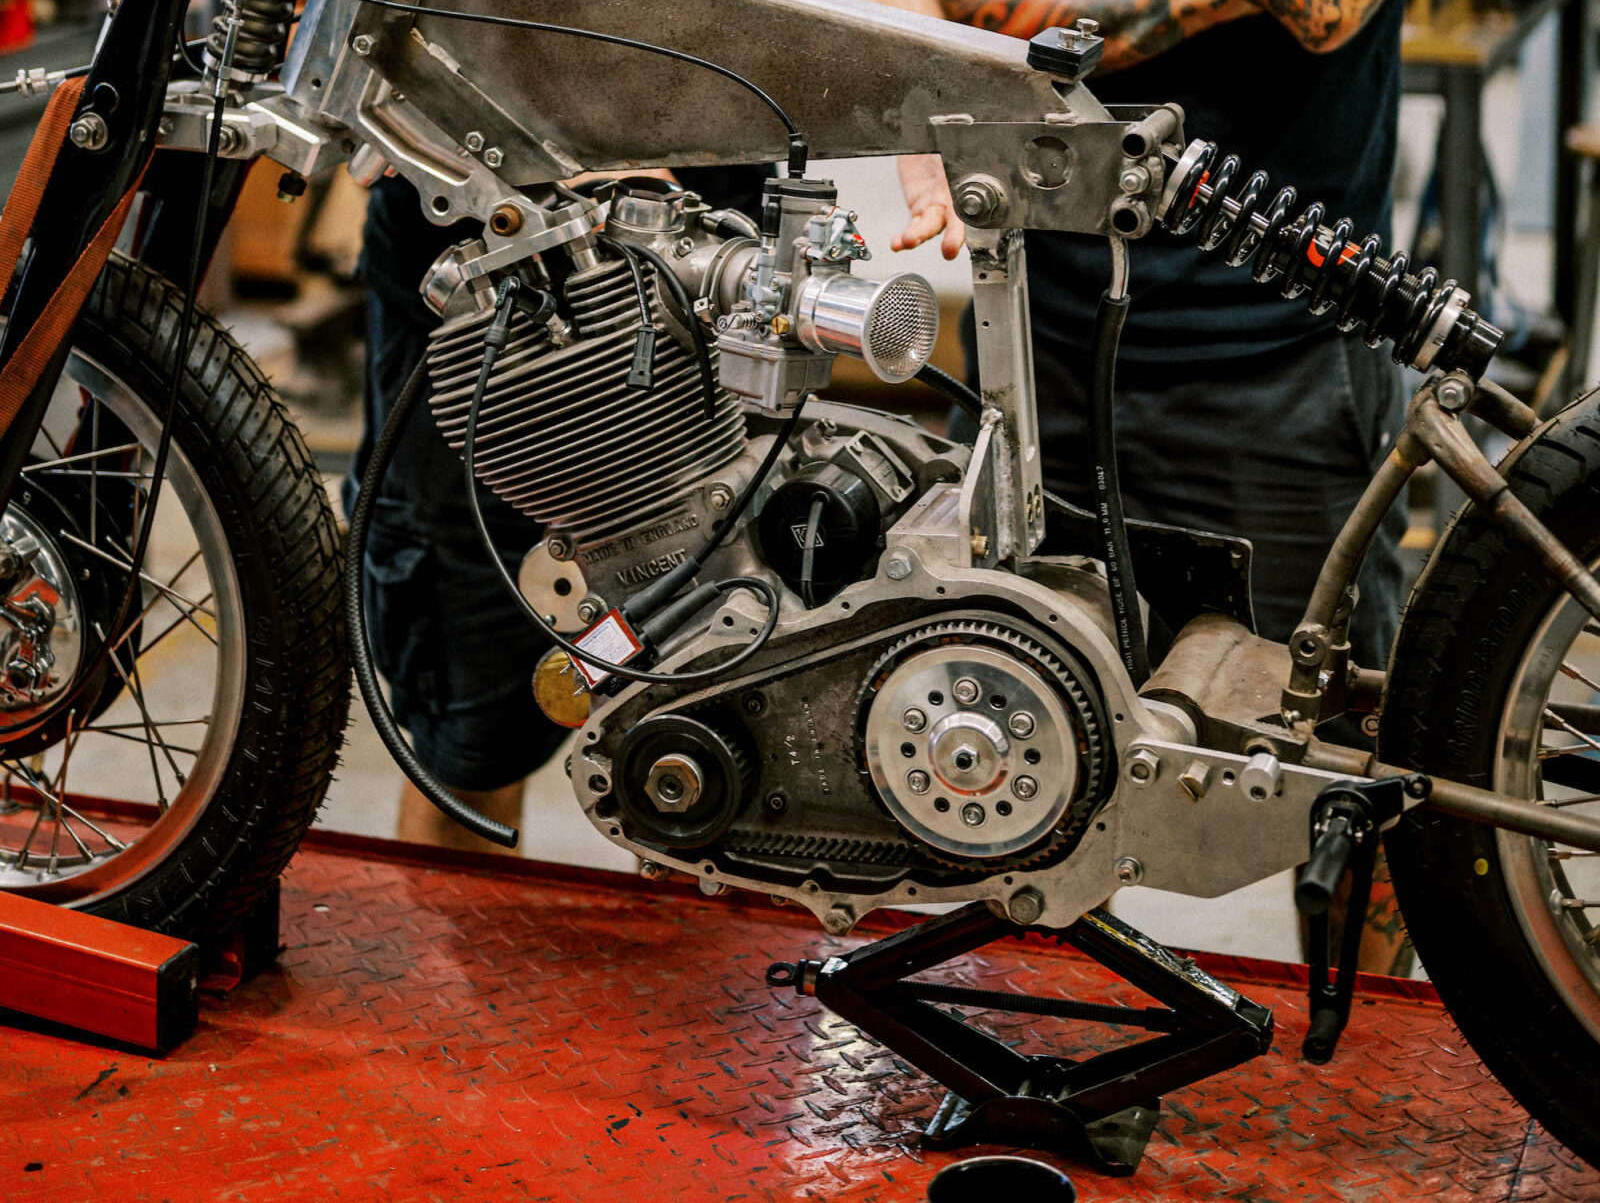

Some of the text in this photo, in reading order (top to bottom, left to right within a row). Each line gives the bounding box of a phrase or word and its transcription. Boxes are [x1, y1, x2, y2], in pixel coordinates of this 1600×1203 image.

[582, 541, 618, 565] MADE
[640, 513, 699, 545] ENGLAND
[1107, 540, 1115, 558] BAR
[616, 548, 687, 587] VINCENT
[1115, 591, 1125, 614] HOSE
[1121, 617, 1131, 648] PETROL
[783, 734, 800, 766] T4/2
